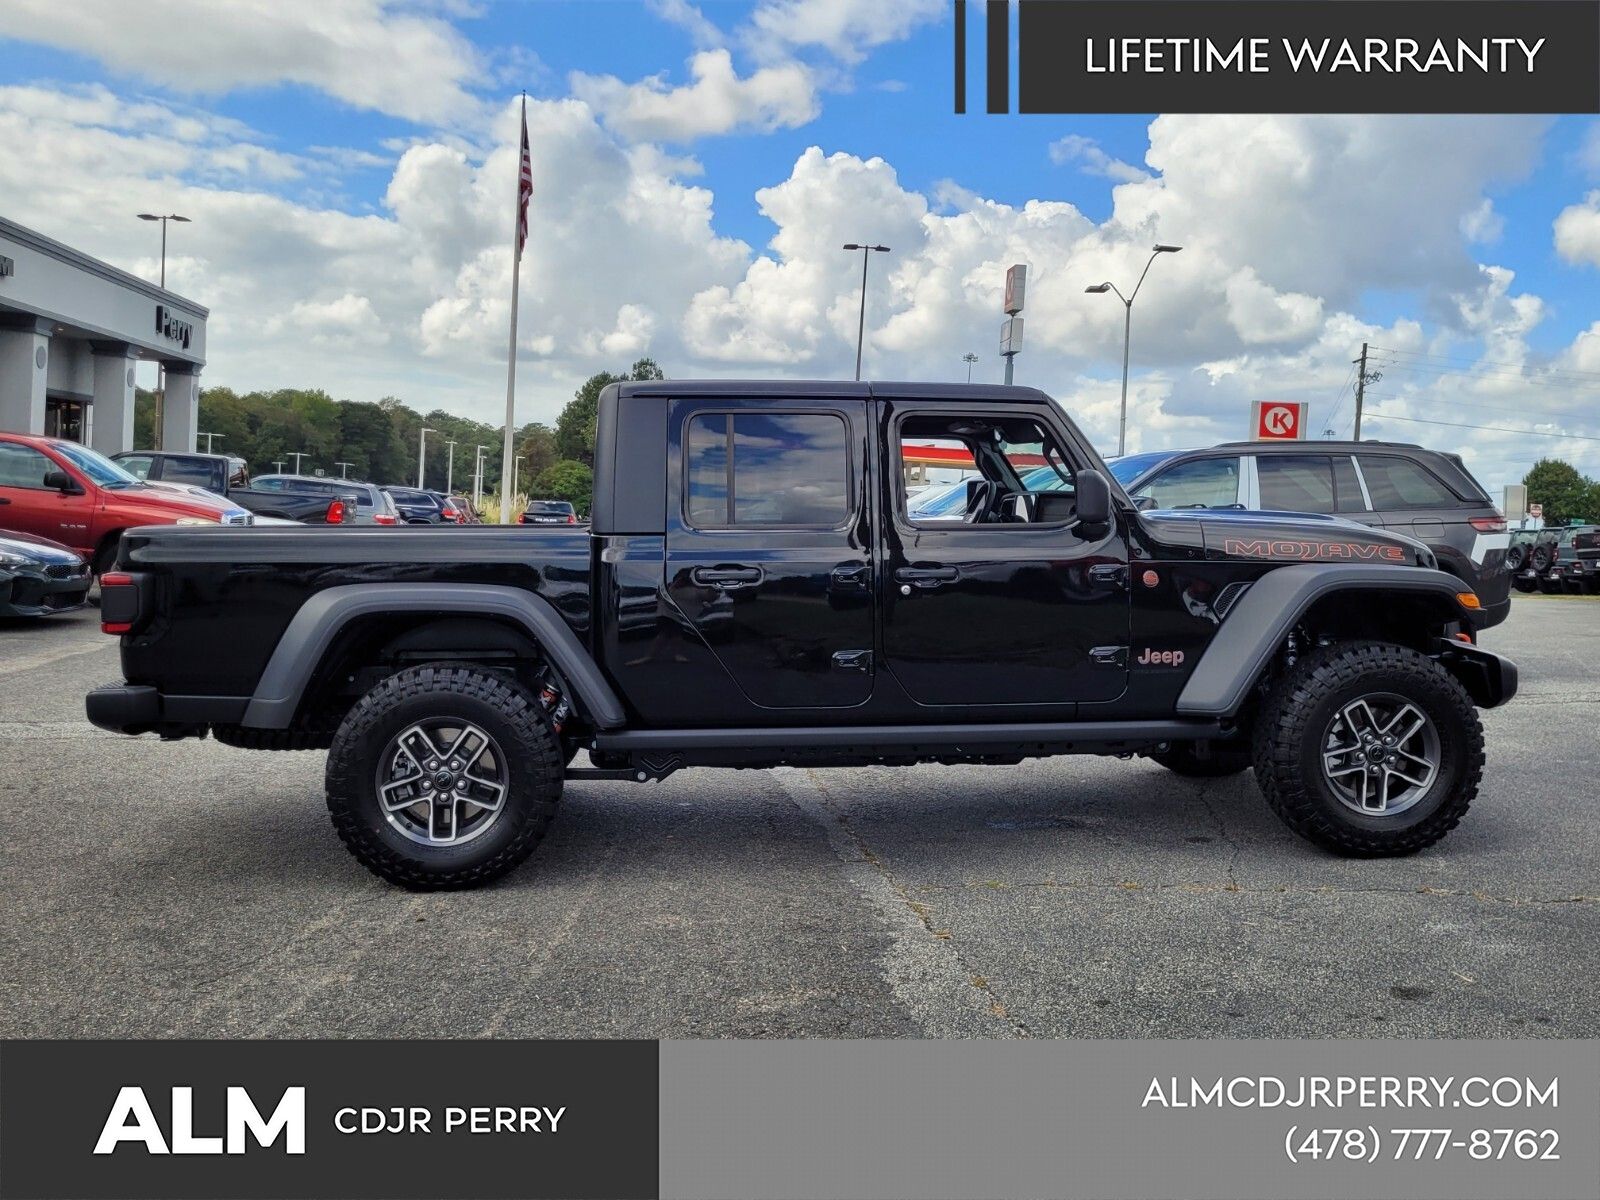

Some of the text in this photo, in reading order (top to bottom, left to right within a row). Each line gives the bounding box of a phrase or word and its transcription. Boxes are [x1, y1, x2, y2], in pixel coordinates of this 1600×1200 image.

[156, 305, 193, 350] Perry
[1224, 539, 1406, 561] MOJAVE
[1137, 647, 1185, 667] Jeep
